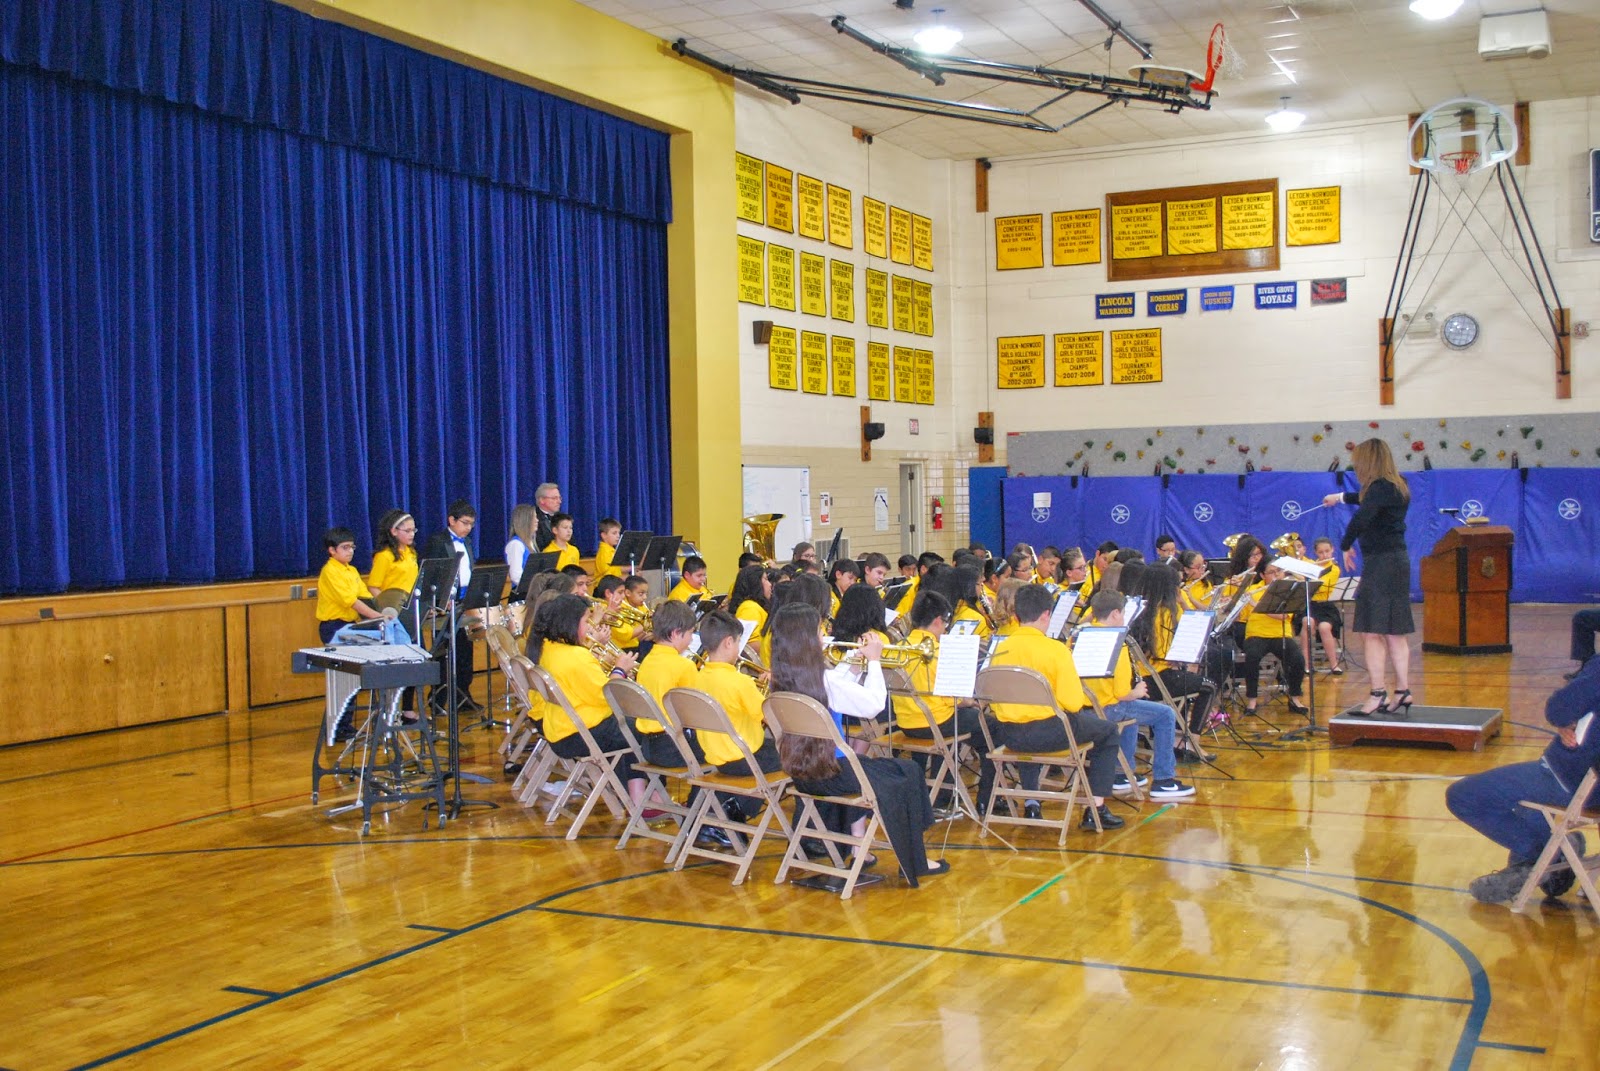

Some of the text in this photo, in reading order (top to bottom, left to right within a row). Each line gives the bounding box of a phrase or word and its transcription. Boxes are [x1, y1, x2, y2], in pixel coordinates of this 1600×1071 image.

[1294, 198, 1330, 206] CONFERENCE
[1230, 203, 1264, 212] CONFERENCE
[1174, 209, 1208, 217] CONFERENCE
[1060, 222, 1092, 230] CONFERENCE
[1258, 287, 1275, 295] RIVER
[1099, 296, 1133, 306] LINCOLN
[1150, 294, 1184, 302] ROSEMONT
[1204, 297, 1232, 306] HUSKIES
[1260, 294, 1292, 304] ROYALS
[1155, 303, 1179, 312] COBRAS
[1099, 308, 1133, 316] WARRIORS
